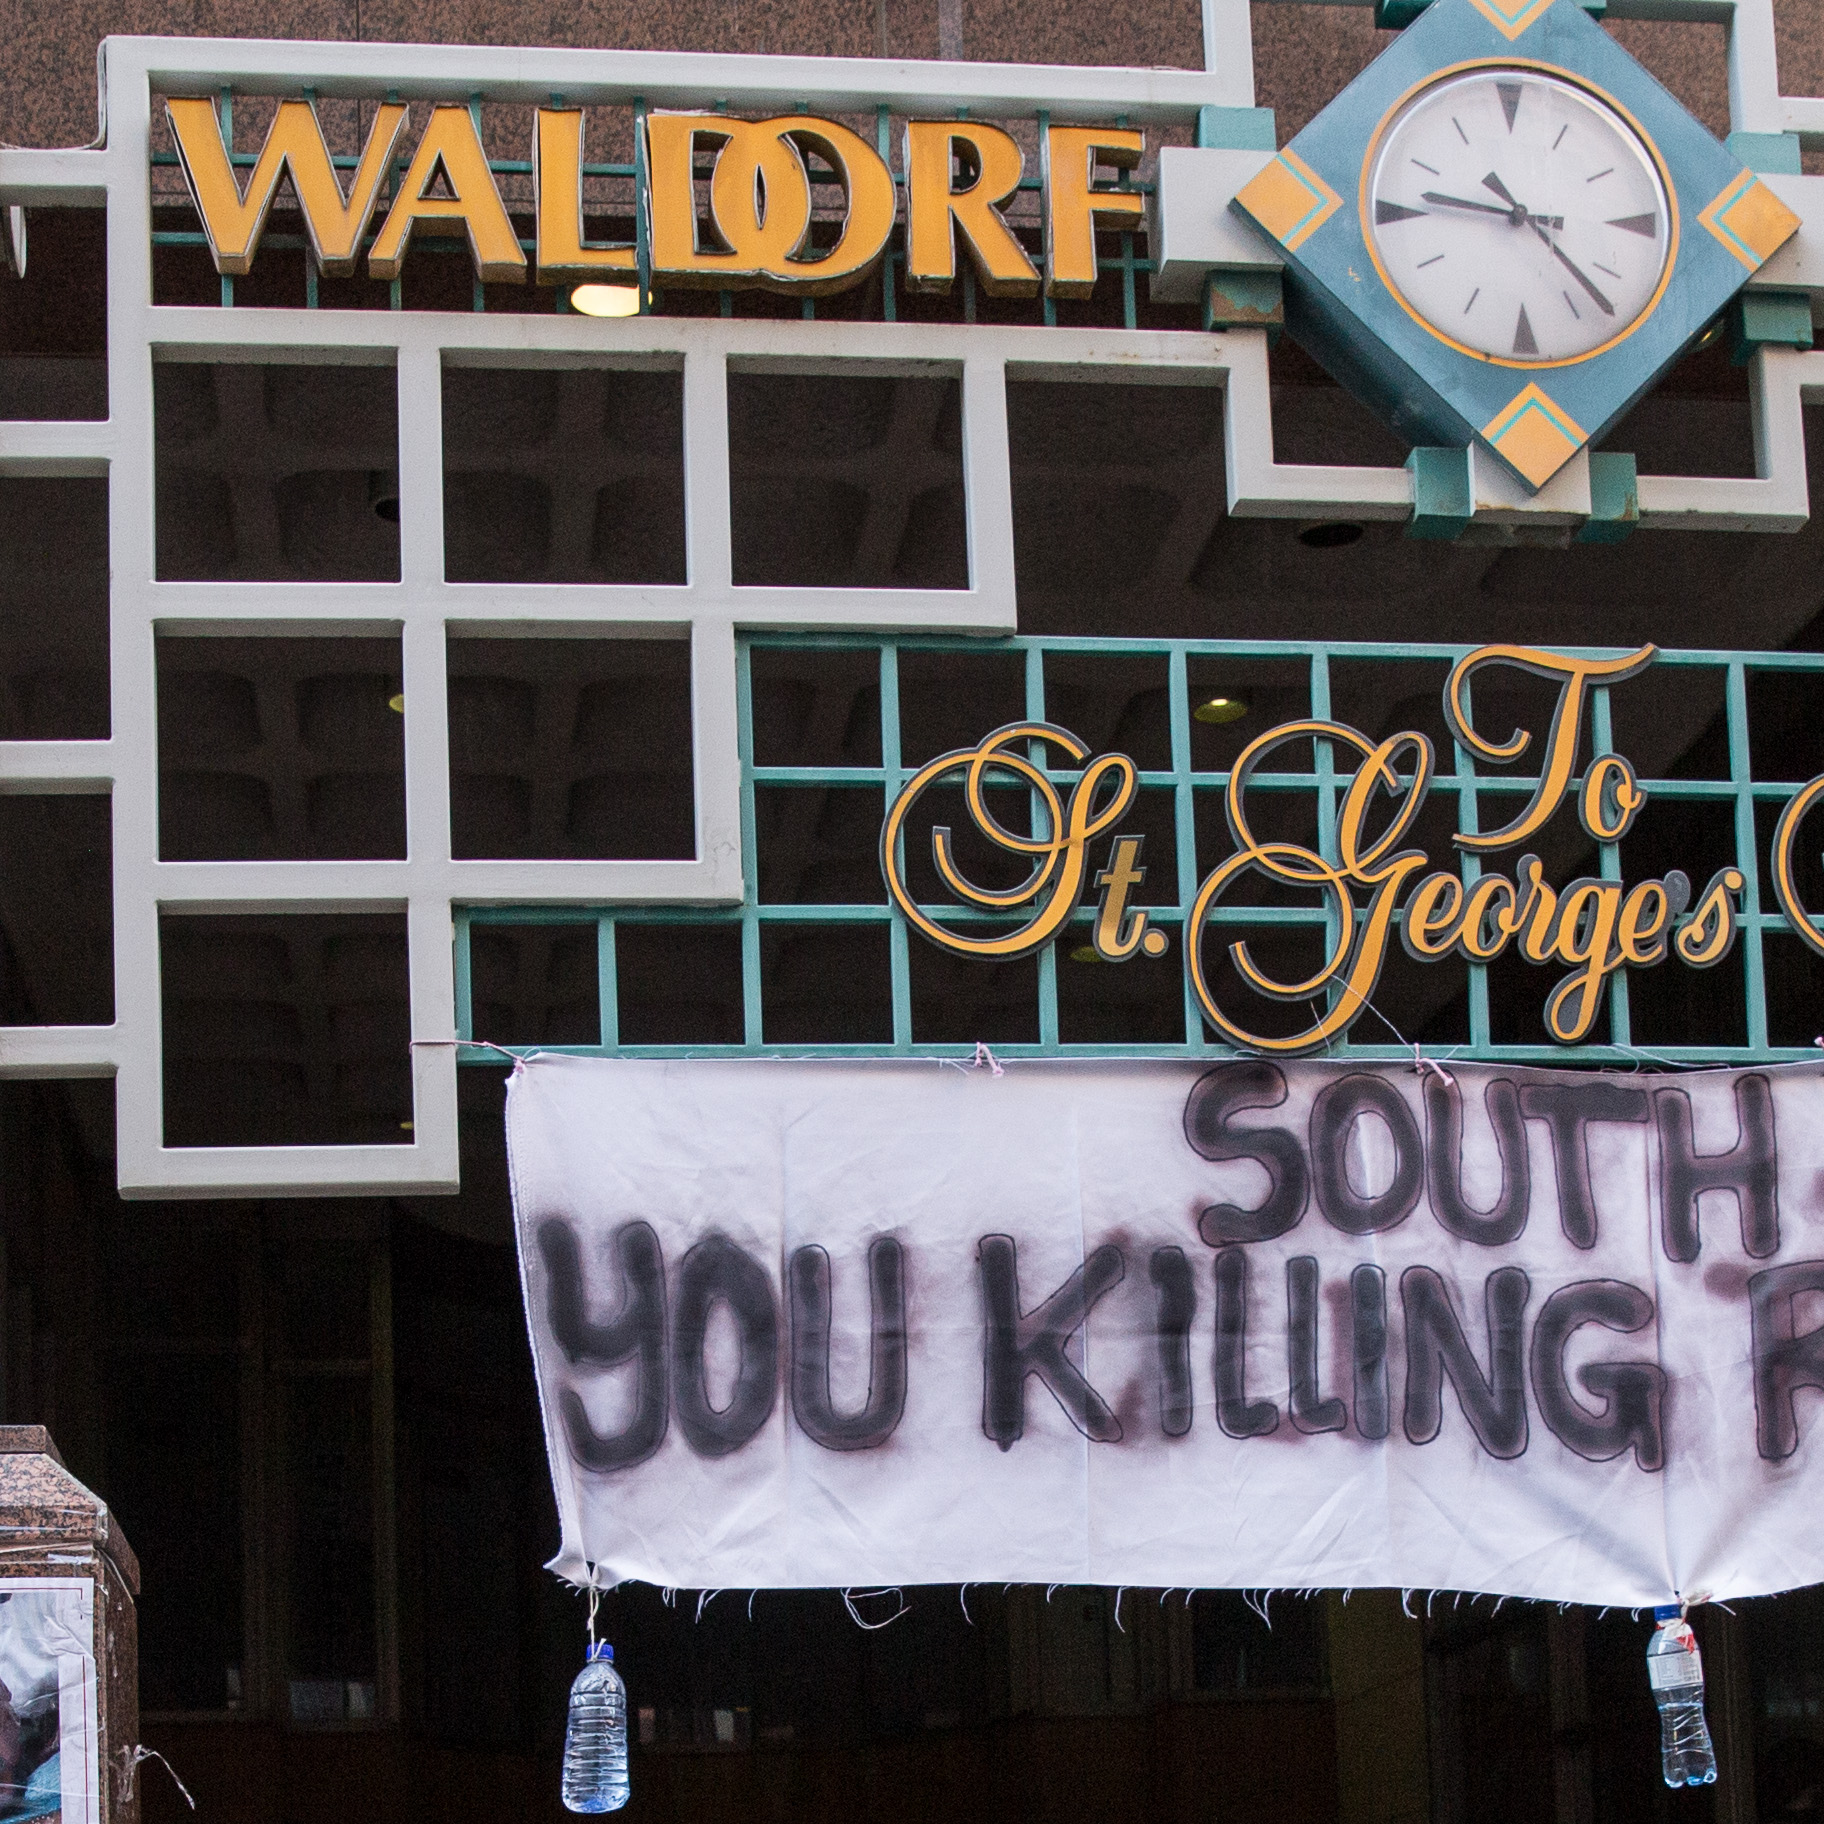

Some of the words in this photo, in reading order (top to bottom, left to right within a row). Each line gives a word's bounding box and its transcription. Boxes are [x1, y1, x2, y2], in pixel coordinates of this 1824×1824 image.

[165, 96, 1146, 300] WALDORF
[1442, 641, 1661, 852] To
[1181, 1061, 1780, 1264] SOUTH
[534, 1220, 908, 1473] YOU
[977, 1231, 1666, 1472] KILLING
